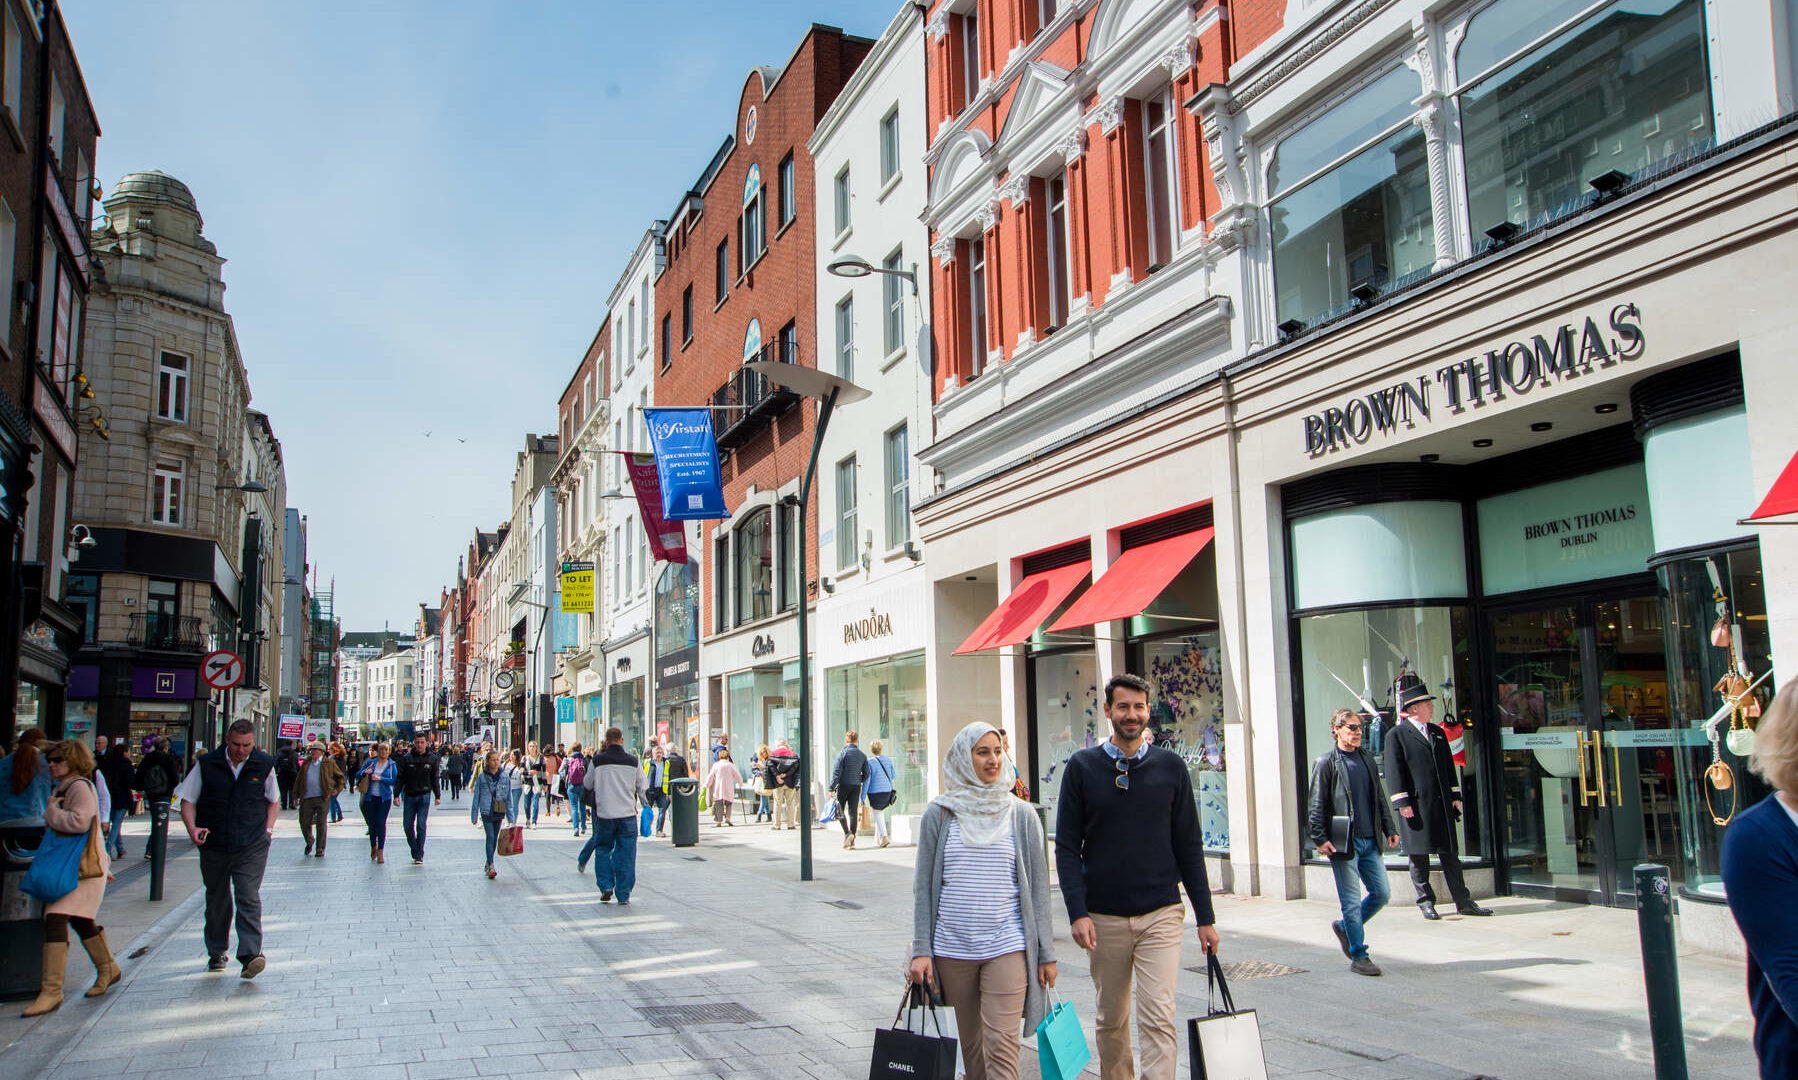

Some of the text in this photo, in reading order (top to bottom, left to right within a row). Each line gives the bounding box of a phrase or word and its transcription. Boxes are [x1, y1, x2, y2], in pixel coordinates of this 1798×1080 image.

[1301, 302, 1646, 459] BROWN THOMAS
[1524, 504, 1636, 540] BROWN THOMAS
[1560, 532, 1598, 548] DUBLIN
[579, 575, 592, 583] LET
[843, 612, 893, 644] PANDORA
[161, 679, 170, 687] H
[888, 1061, 915, 1073] CHANEL
